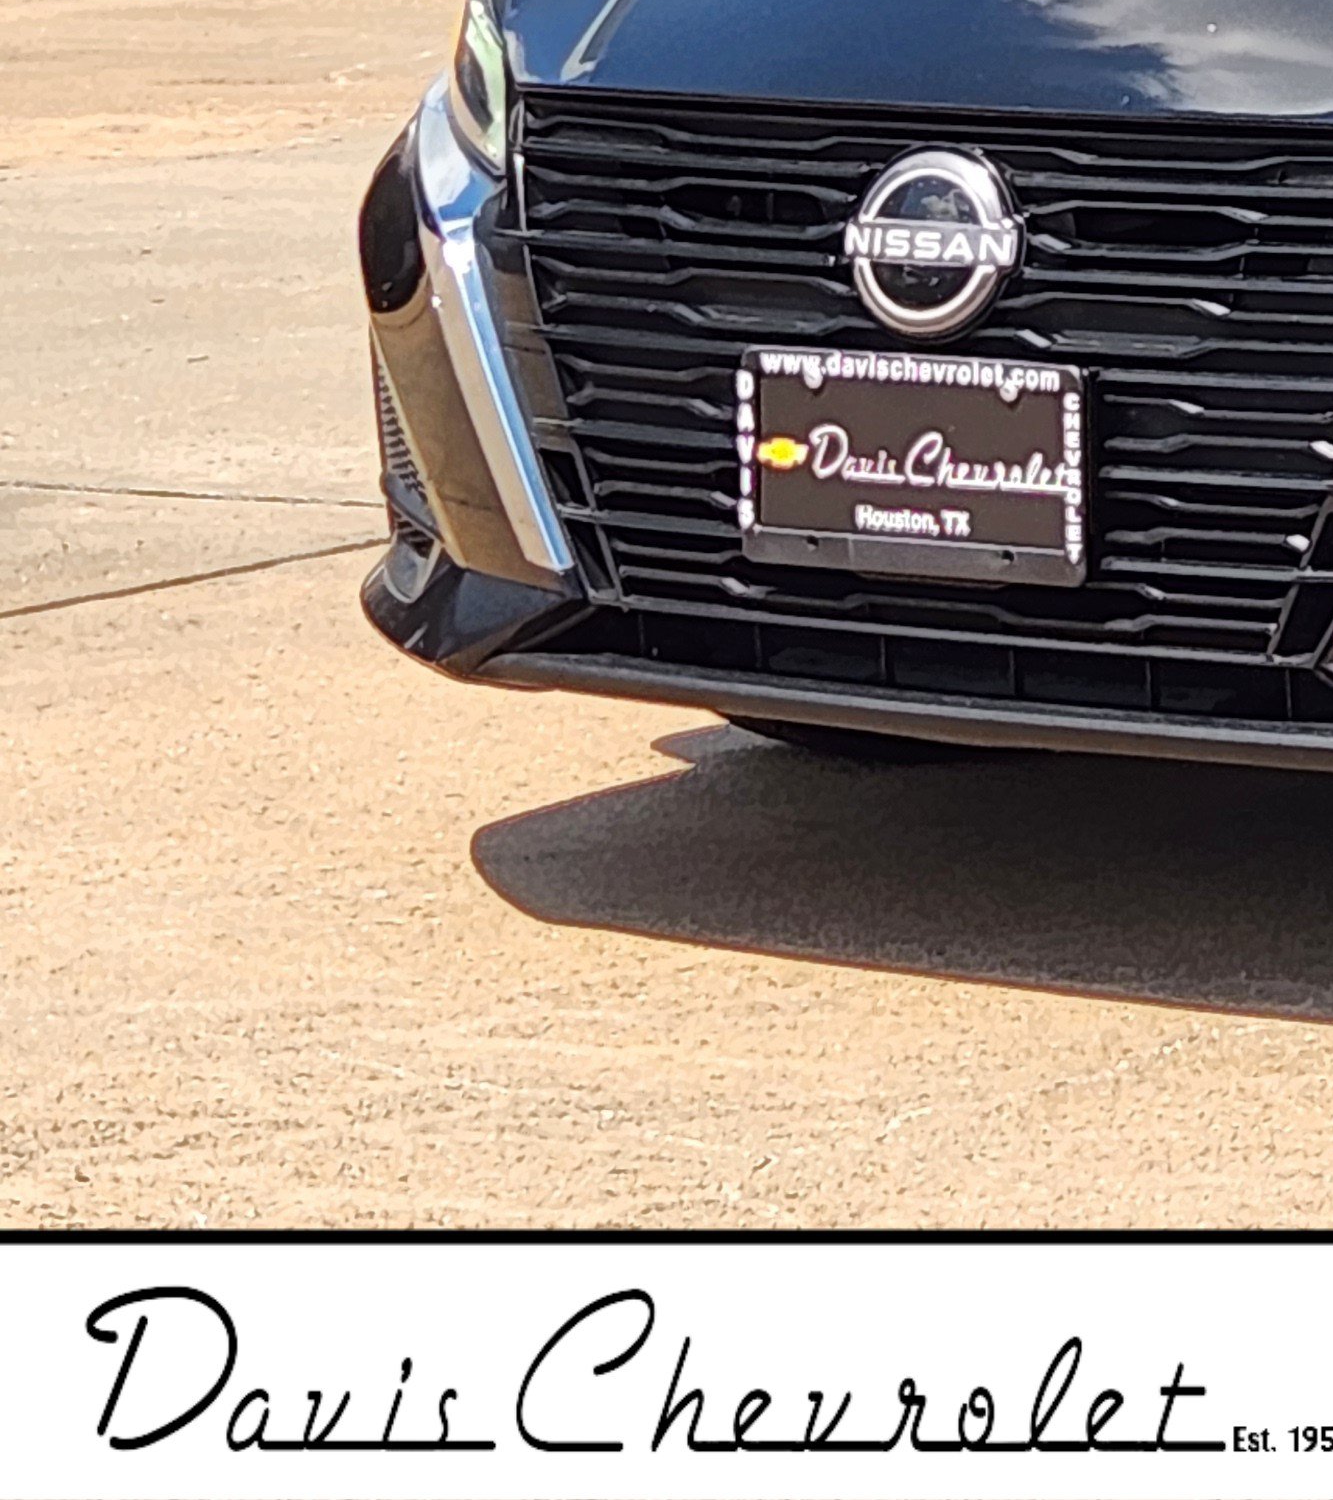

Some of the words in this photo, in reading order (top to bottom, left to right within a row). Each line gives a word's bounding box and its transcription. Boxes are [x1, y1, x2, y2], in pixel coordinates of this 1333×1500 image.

[844, 223, 1013, 263] NISSAN
[808, 423, 906, 485] Davis
[904, 431, 1068, 495] Chevrolet
[855, 503, 940, 537] Houston,
[941, 509, 972, 537] TX
